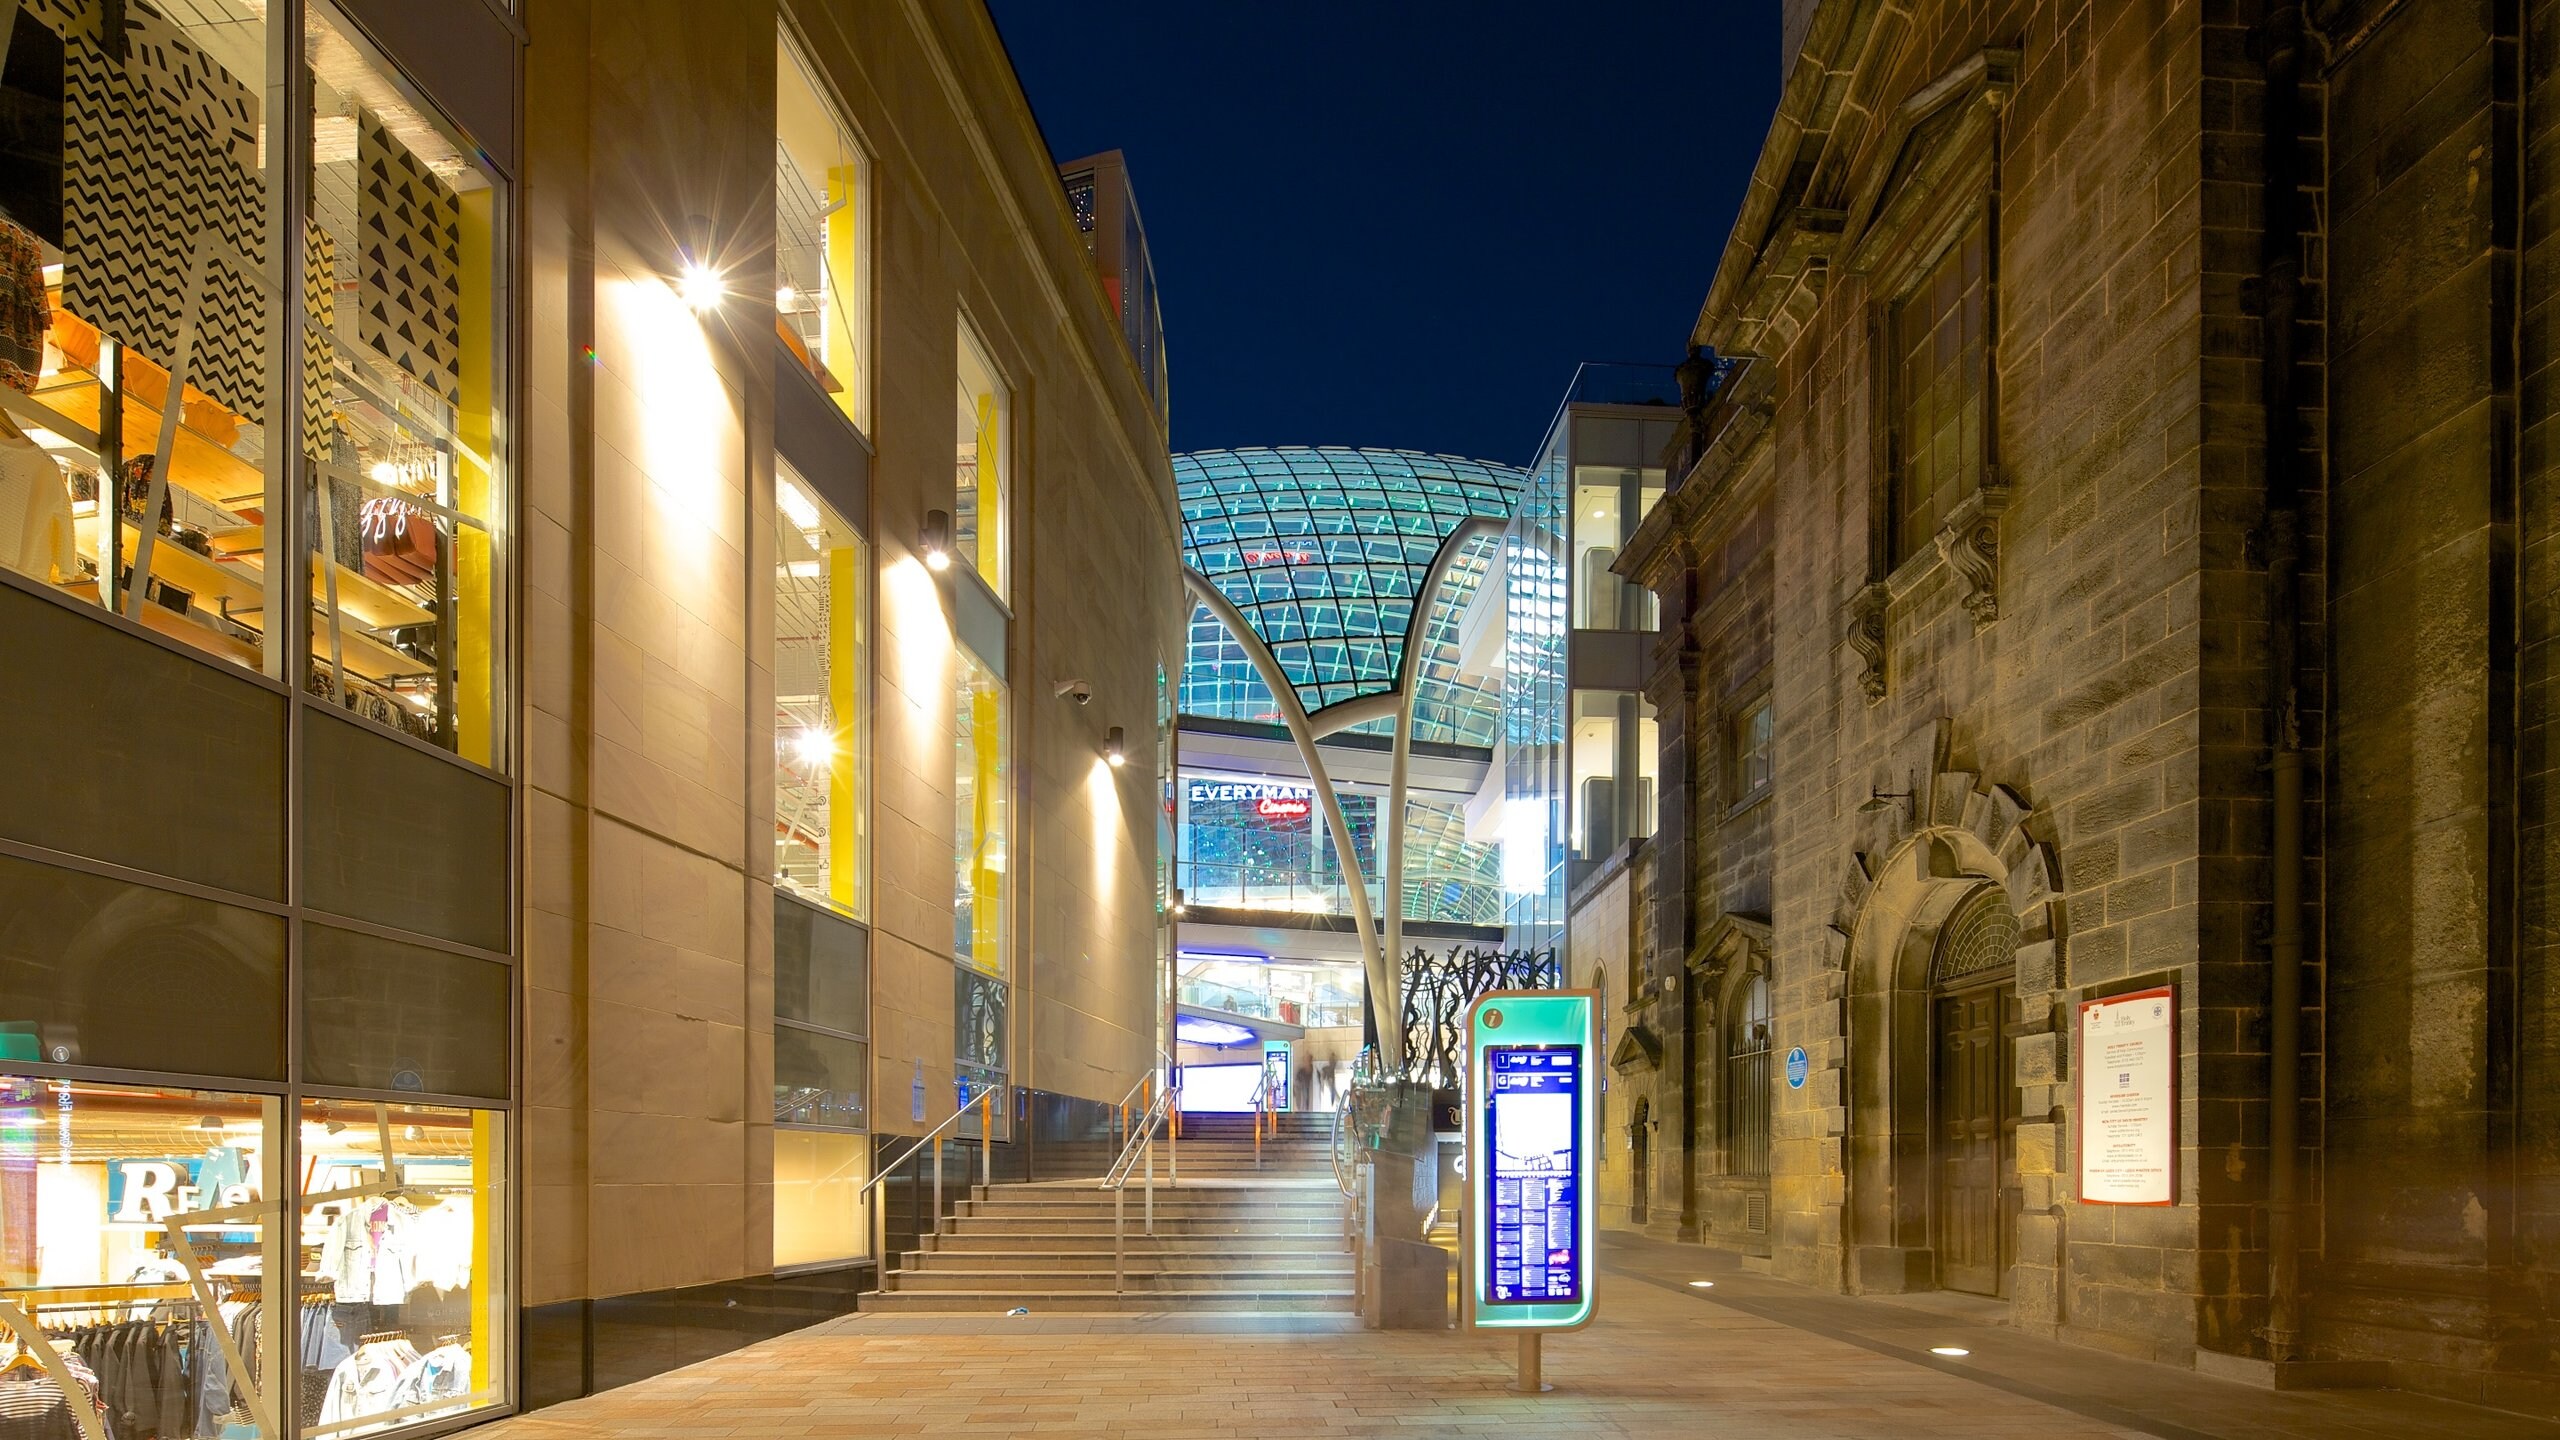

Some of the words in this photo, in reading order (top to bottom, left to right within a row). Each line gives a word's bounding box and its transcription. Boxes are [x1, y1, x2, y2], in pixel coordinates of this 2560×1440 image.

[1191, 784, 1309, 802] EVERYMAN
[1259, 799, 1308, 815] Cinema
[1498, 1075, 1507, 1085] G
